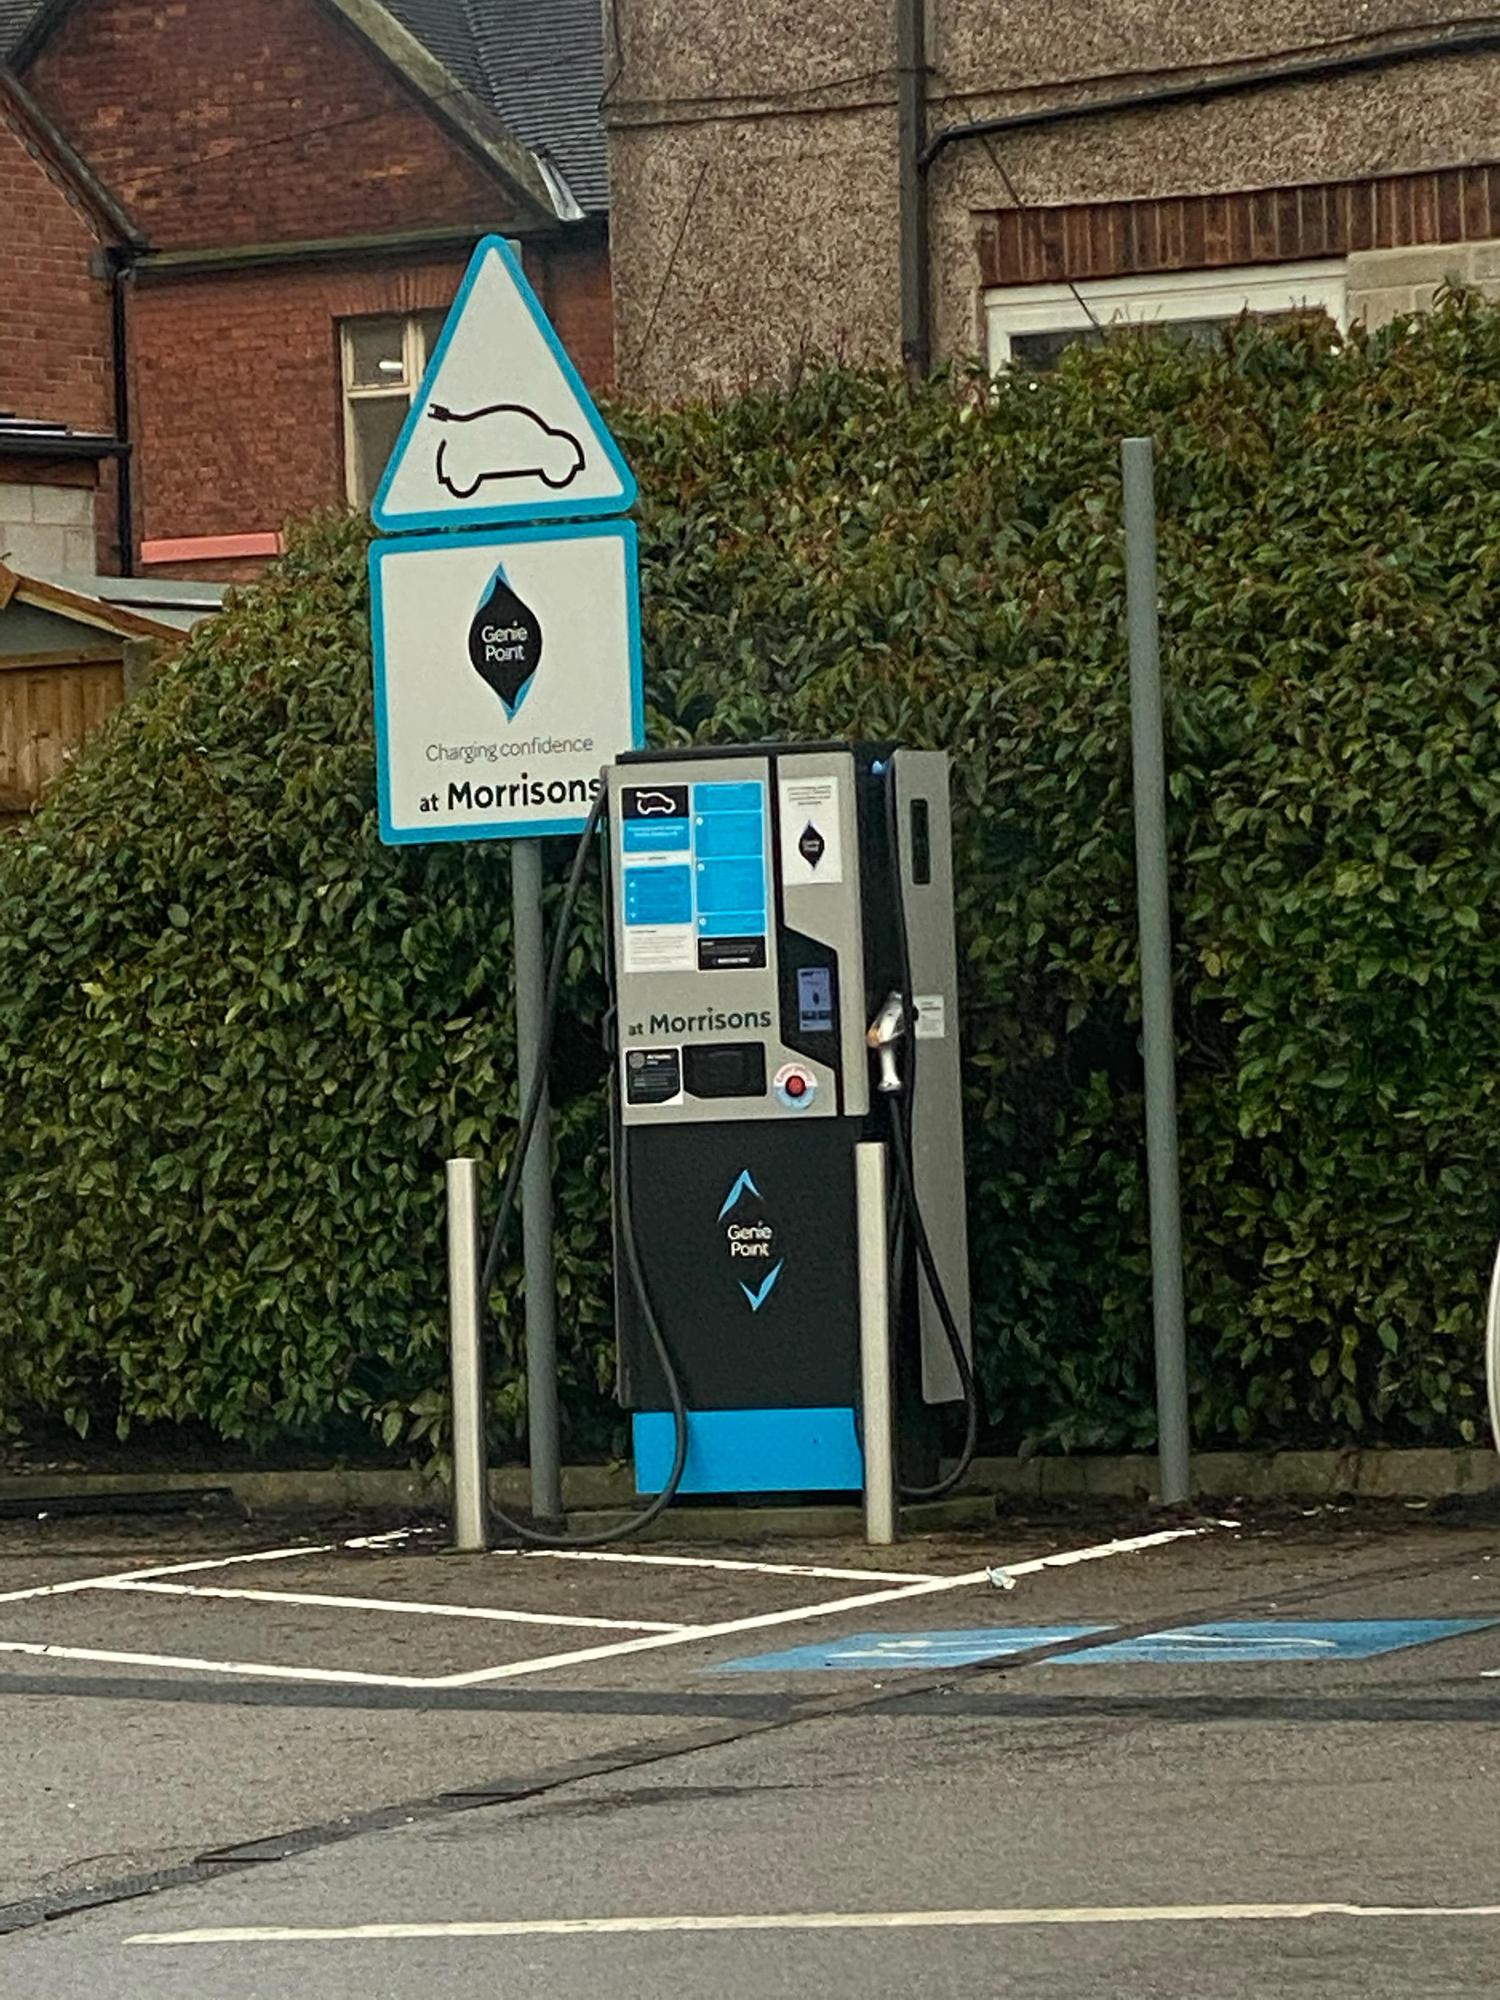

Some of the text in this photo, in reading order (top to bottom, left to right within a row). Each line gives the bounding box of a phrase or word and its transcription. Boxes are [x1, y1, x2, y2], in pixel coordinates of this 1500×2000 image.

[481, 620, 528, 644] Genie
[485, 644, 526, 662] Point
[425, 736, 594, 764] Charging confidence
[419, 772, 601, 812] at Morrisons
[628, 1007, 772, 1036] at Morrisons
[727, 1219, 773, 1240] Genie
[730, 1241, 770, 1257] Point
